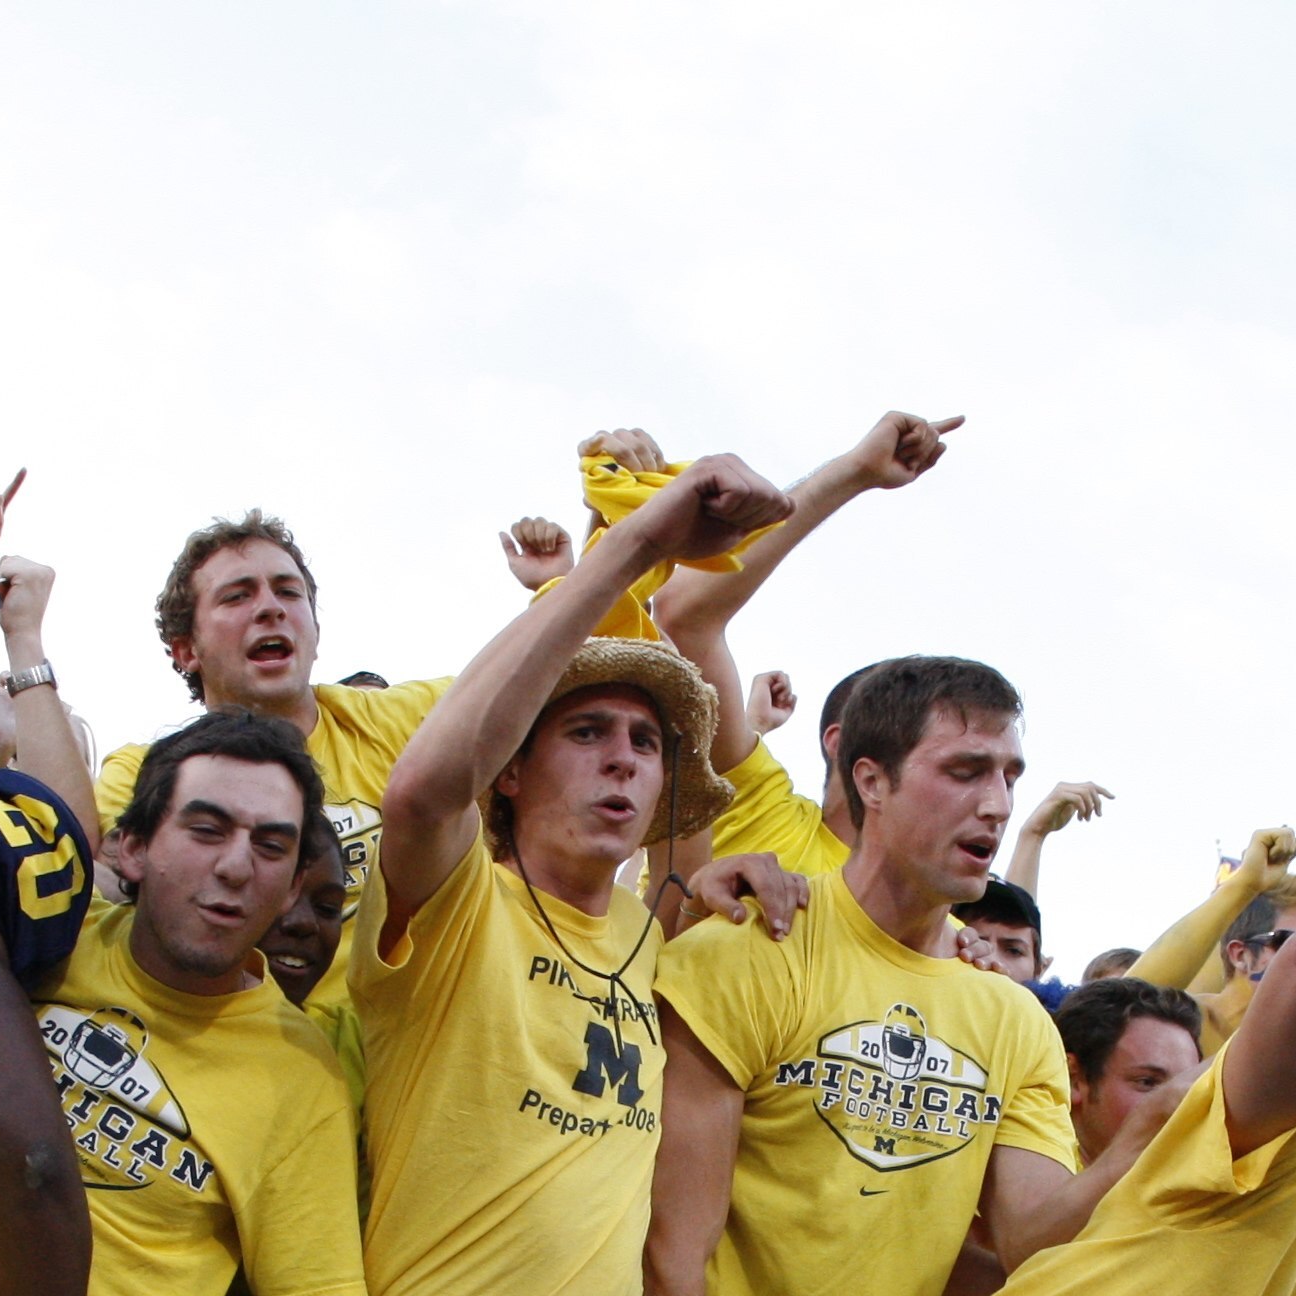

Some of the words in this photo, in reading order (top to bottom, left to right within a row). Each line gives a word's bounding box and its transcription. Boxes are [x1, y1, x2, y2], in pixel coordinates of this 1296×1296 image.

[861, 1040, 880, 1059] 20
[926, 1056, 949, 1074] 07
[120, 1077, 150, 1103] 07
[776, 1060, 1002, 1124] MICHIGAN
[617, 1106, 656, 1133] 008
[822, 1091, 970, 1138] FOOTBALL
